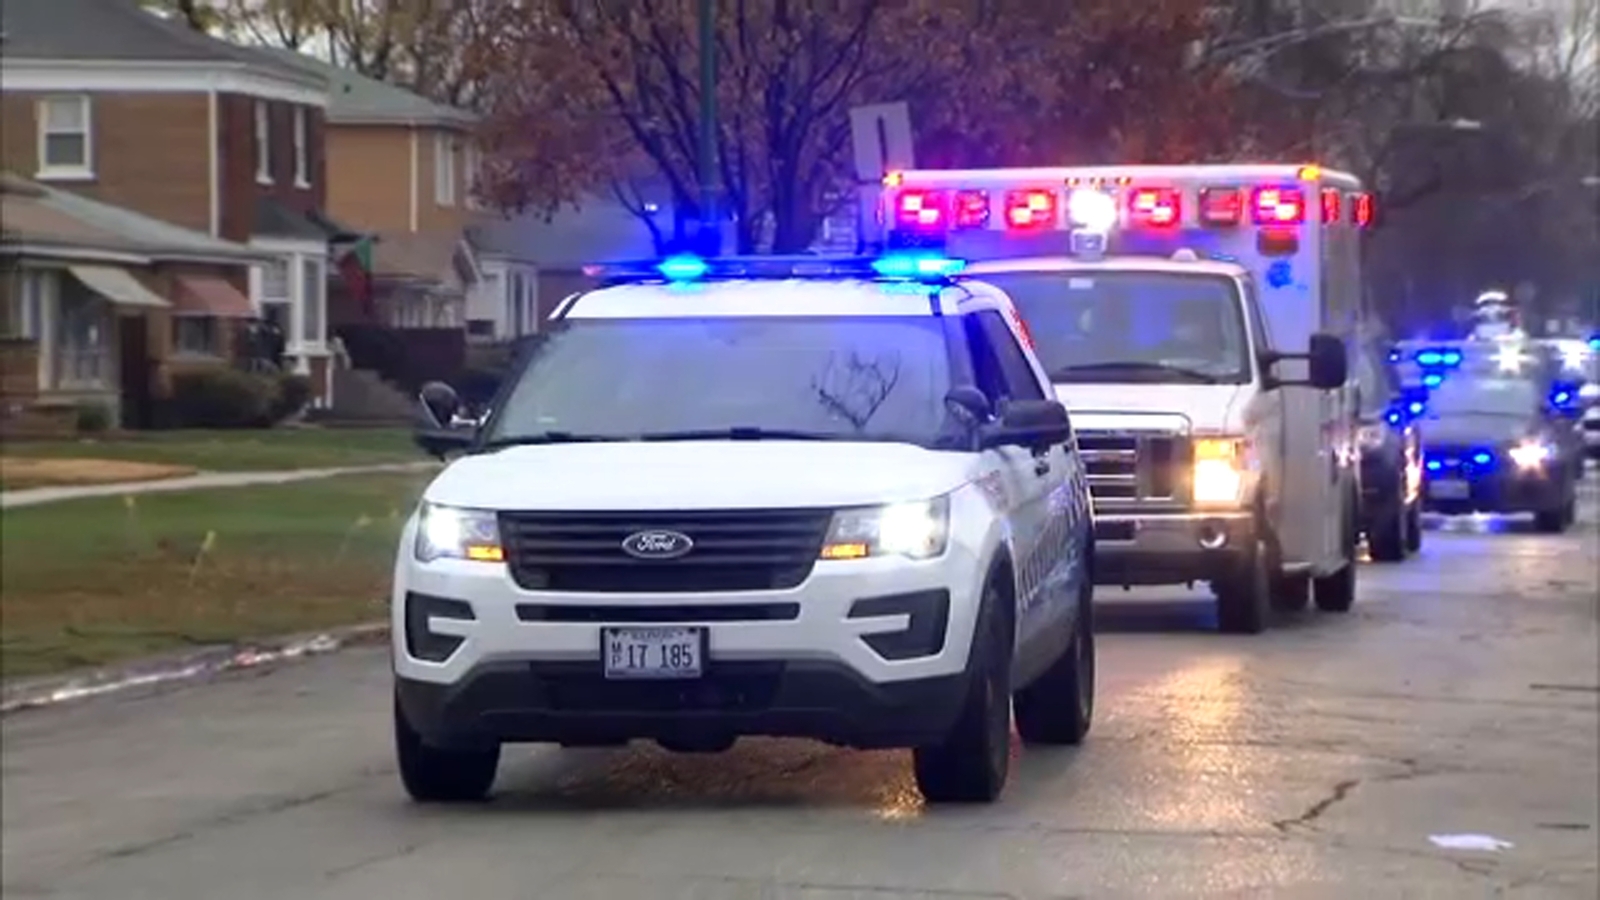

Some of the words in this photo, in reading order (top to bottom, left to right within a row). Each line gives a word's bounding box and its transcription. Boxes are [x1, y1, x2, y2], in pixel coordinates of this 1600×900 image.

[637, 534, 676, 551] Ford
[627, 644, 648, 669] 17
[660, 644, 693, 669] 185
